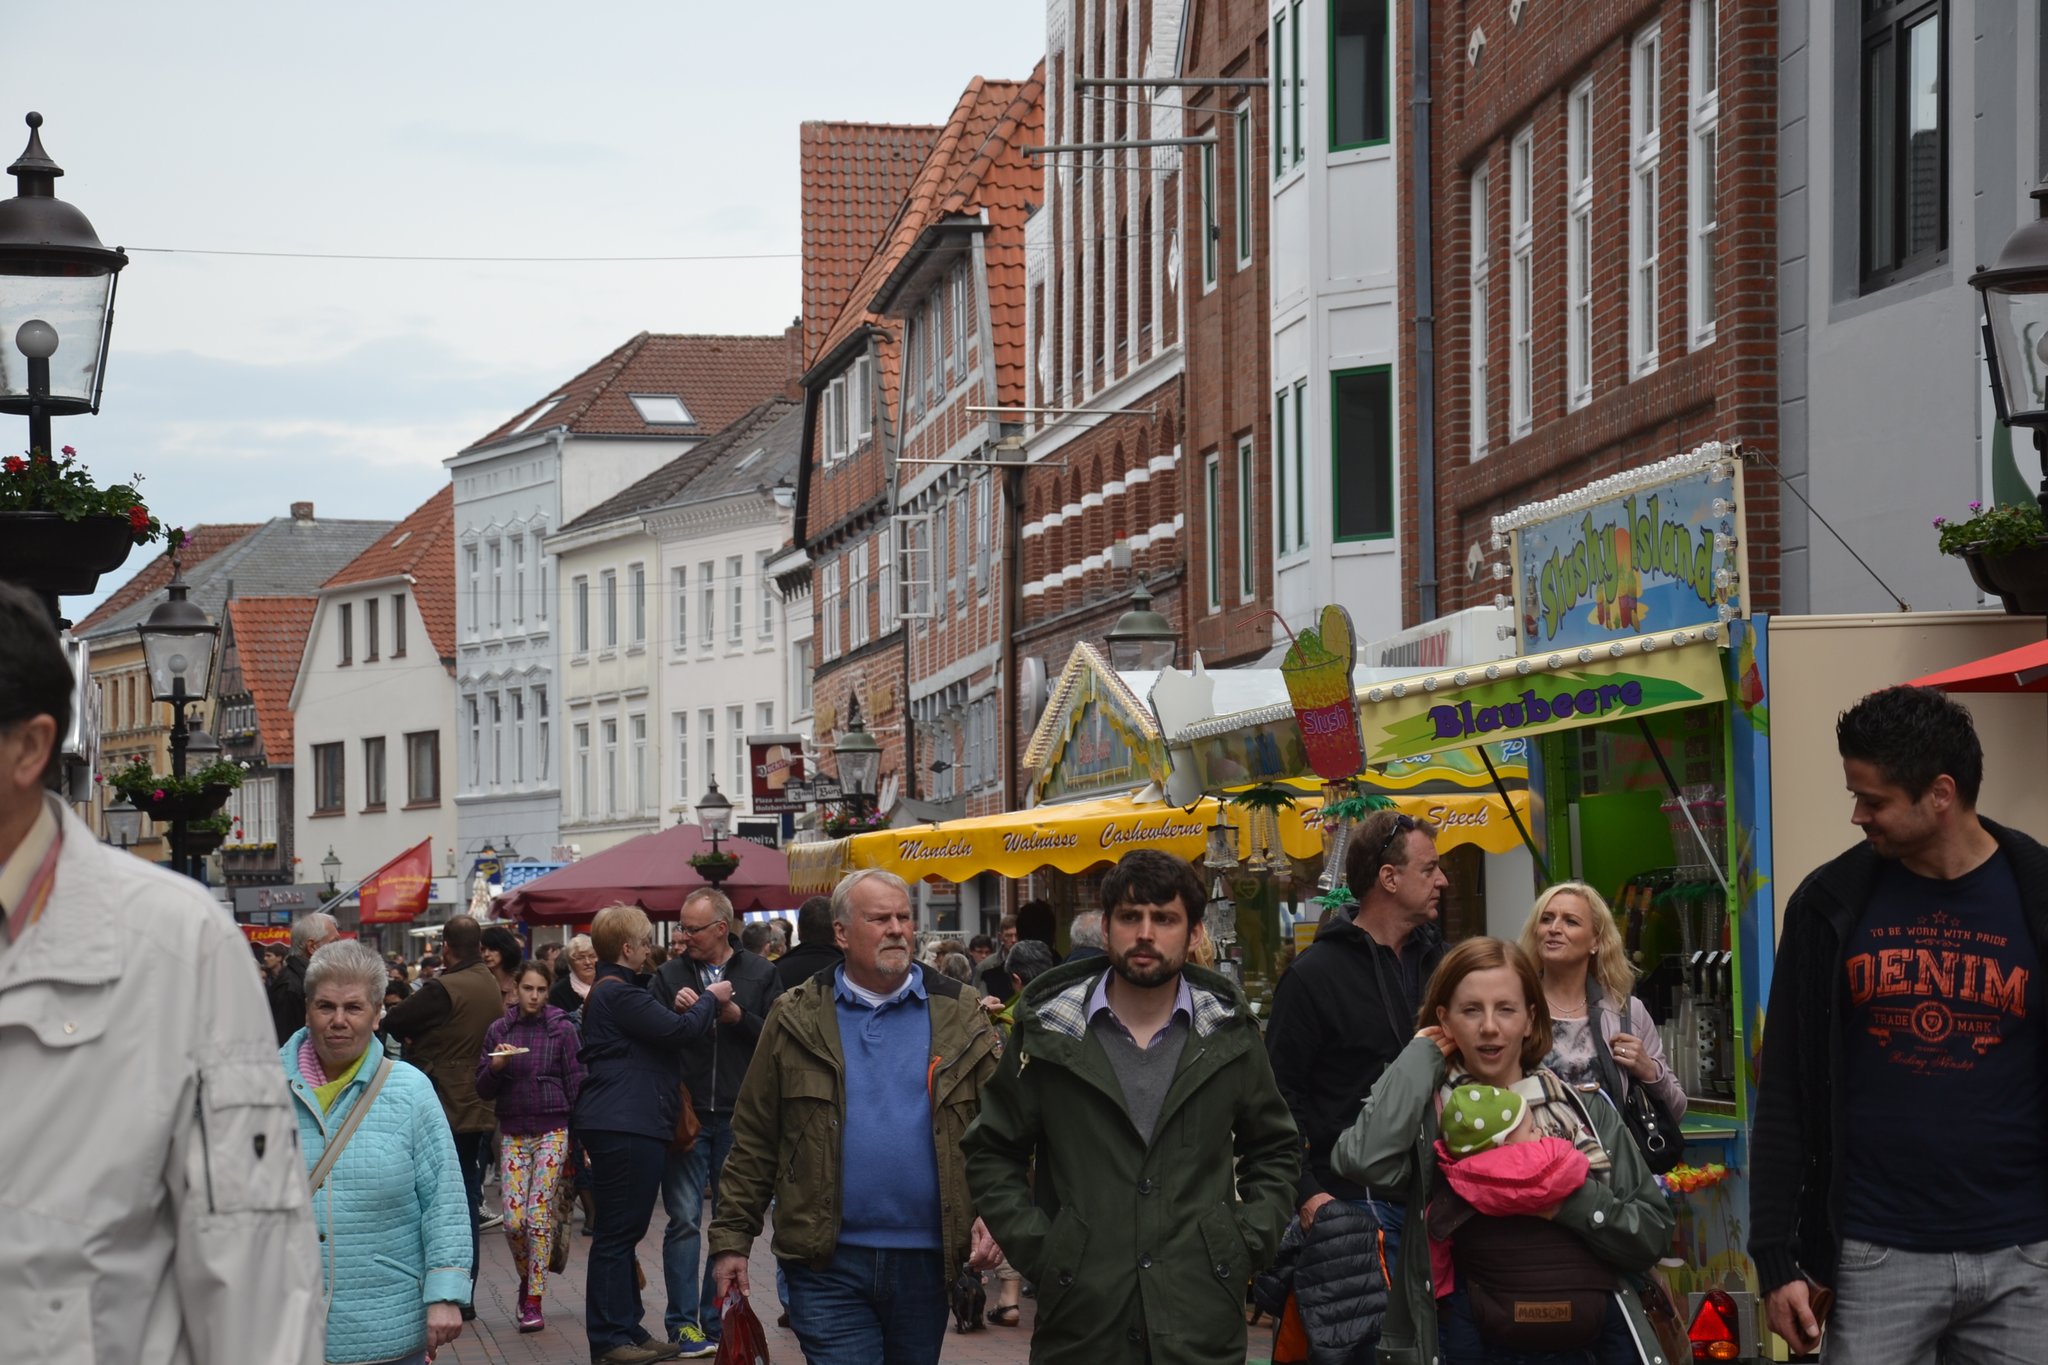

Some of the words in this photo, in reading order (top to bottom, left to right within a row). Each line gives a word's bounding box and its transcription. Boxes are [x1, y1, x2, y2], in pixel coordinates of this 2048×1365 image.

[1540, 511, 1619, 641] Slushy
[1623, 493, 1716, 608] Island
[1303, 704, 1348, 735] Slush
[1427, 680, 1643, 740] Blaubeere
[1427, 805, 1489, 832] Speck
[899, 838, 973, 861] Mandeln
[1003, 829, 1079, 854] Walnüsse
[1099, 818, 1204, 850] Cashewkerne
[1870, 928, 1884, 937] TO
[1888, 926, 1901, 936] BE
[1907, 926, 1938, 938] WORN
[1943, 928, 1972, 941] WITH
[1976, 931, 2008, 947] PRIDE
[1846, 948, 2029, 1019] DENIM
[1874, 1013, 1909, 1026] TRADE
[1957, 1020, 1993, 1033] MARK
